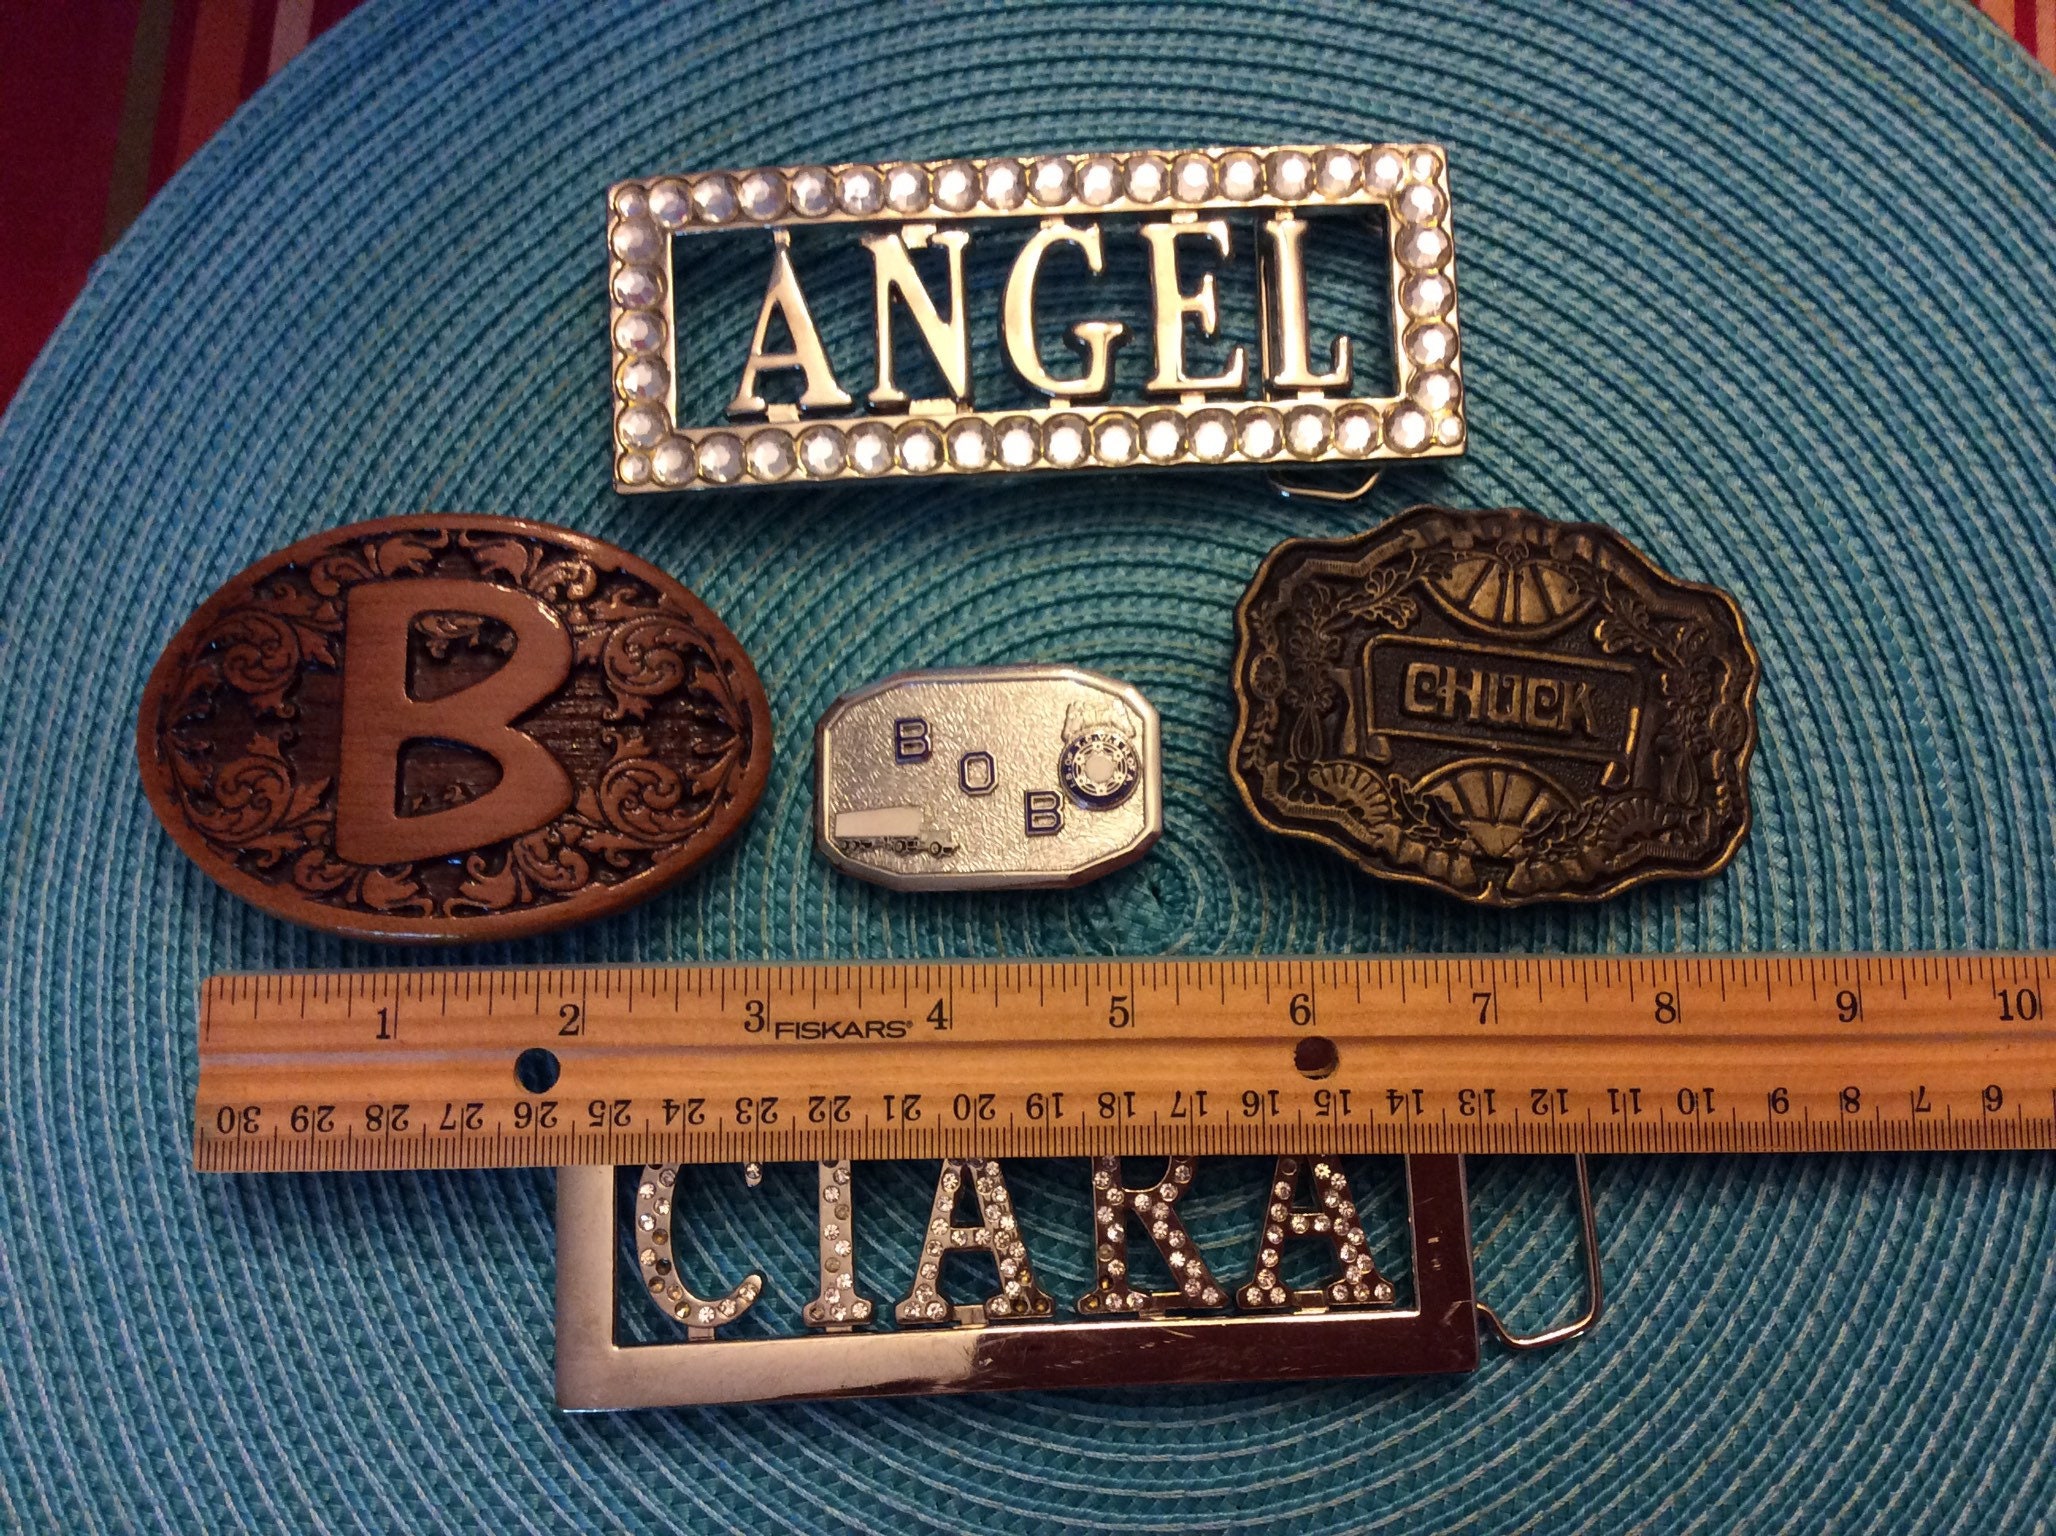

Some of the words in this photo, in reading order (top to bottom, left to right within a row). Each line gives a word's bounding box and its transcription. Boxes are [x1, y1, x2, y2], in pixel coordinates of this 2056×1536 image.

[726, 218, 1353, 415] ANGEL
[1404, 662, 1599, 737] CHUCK
[335, 577, 574, 866] B
[375, 1007, 391, 1040] 1
[558, 1003, 581, 1037] 2
[743, 1000, 765, 1033] 3
[926, 998, 949, 1031] 4
[1108, 995, 1130, 1029] 5
[1289, 993, 1311, 1026] 6
[1471, 992, 1493, 1025] 7
[1654, 991, 1677, 1024] 8
[1835, 990, 1859, 1023] 9
[1998, 989, 2039, 1022] 10
[661, 1098, 706, 1126] 24
[735, 1097, 779, 1125] 23
[808, 1095, 852, 1123] 22
[883, 1094, 922, 1121] 21
[953, 1093, 997, 1122] 20
[1026, 1092, 1065, 1120] 19
[1099, 1091, 1137, 1120] 18
[1170, 1090, 1209, 1119] 17
[1242, 1089, 1281, 1118] 16
[1314, 1088, 1352, 1117] 15
[1385, 1087, 1425, 1116] 14
[1458, 1087, 1497, 1116] 13
[1531, 1087, 1569, 1116] 12
[1606, 1087, 1643, 1115] 11
[1677, 1086, 1716, 1115] 10
[1771, 1086, 1790, 1115] 9
[1841, 1085, 1861, 1114] 8
[1914, 1085, 1932, 1114] 7
[1984, 1084, 2004, 1113] 6
[216, 1105, 262, 1134] 30
[290, 1105, 336, 1133] 29
[365, 1104, 411, 1131] 28
[439, 1102, 485, 1131] 27
[513, 1101, 559, 1129] 26
[588, 1100, 632, 1128] 25
[632, 1156, 1397, 1328] CIARA
